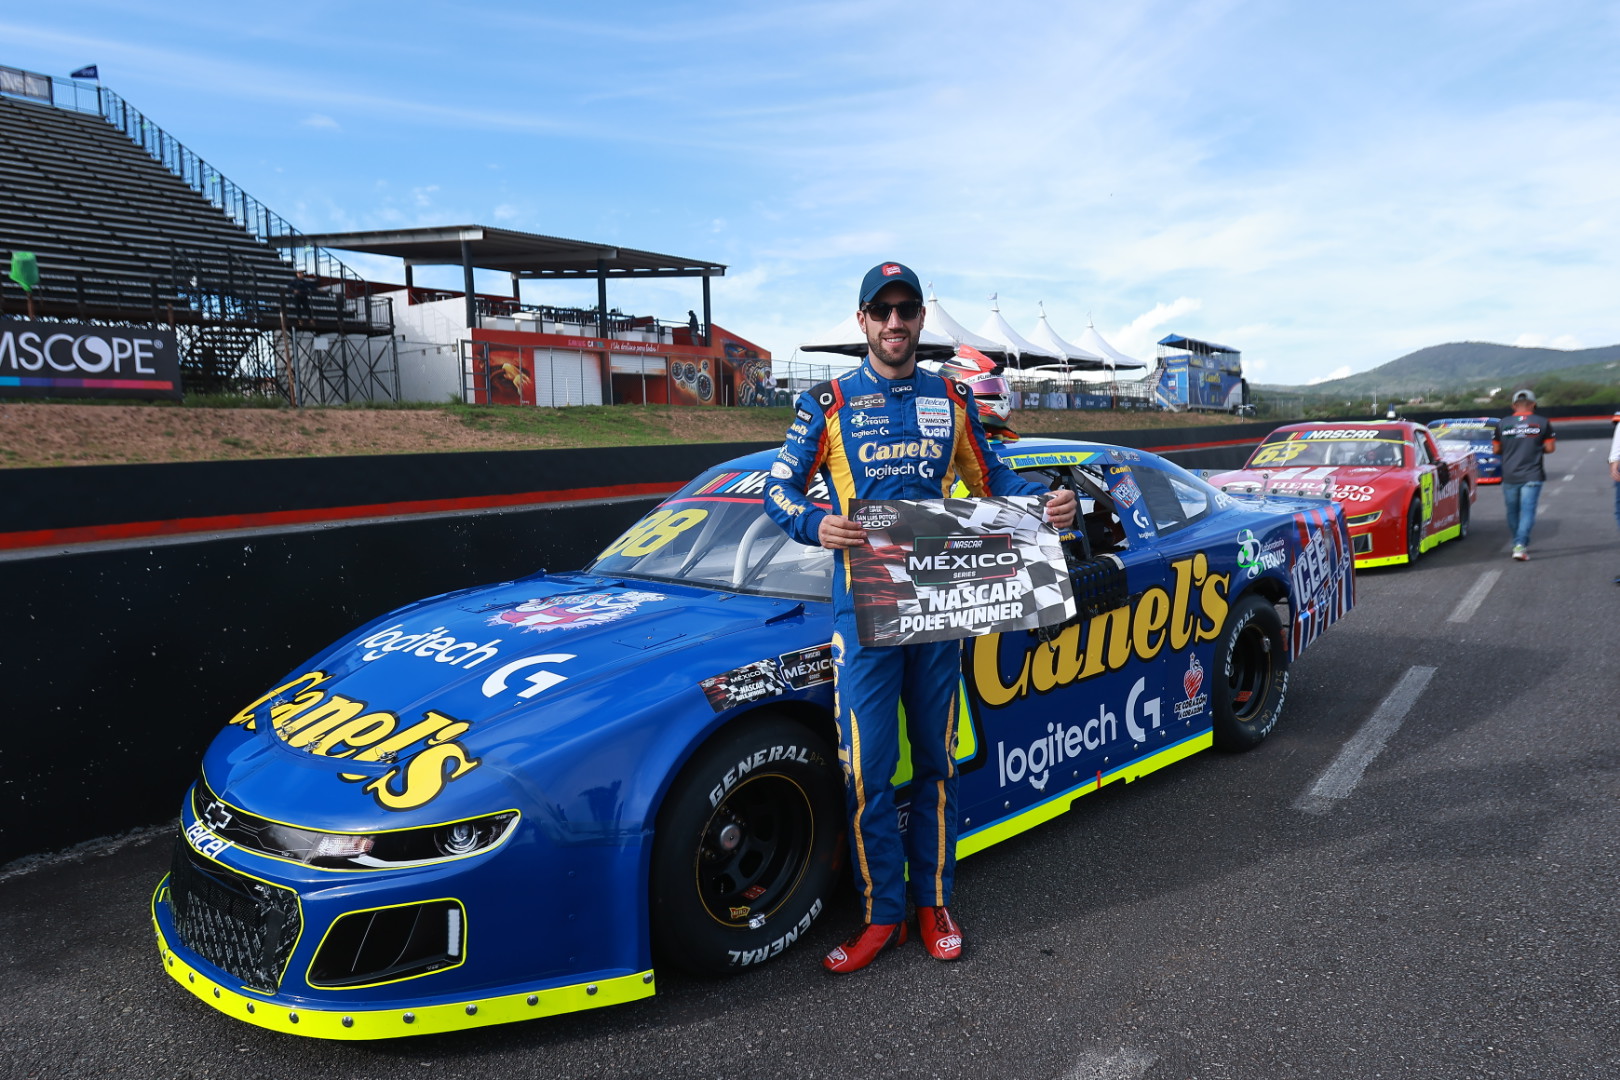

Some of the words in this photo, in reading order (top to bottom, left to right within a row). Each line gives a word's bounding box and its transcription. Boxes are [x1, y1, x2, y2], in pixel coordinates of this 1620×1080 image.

[851, 429, 878, 439] logitech
[1308, 429, 1379, 440] NASCAR
[858, 438, 943, 464] Canel's
[1251, 443, 1308, 465] 63
[865, 462, 915, 480] logitech
[1270, 481, 1375, 494] HERALDO
[597, 509, 709, 561] 88
[862, 520, 891, 528] 200
[953, 540, 983, 549] NASCAR
[909, 551, 1019, 571] MÉXICO
[1260, 548, 1286, 571] TEQUIS
[1291, 528, 1328, 614] ICEE
[953, 570, 977, 579] SERIES
[928, 580, 1022, 612] NASCAR
[899, 614, 945, 633] POLE
[949, 602, 1024, 628] WINNER
[974, 552, 1230, 706] Canel's
[356, 623, 502, 670] logitech
[1224, 609, 1256, 677] GENERAL
[784, 657, 834, 680] MÉXIC
[228, 670, 480, 810] Canel's
[997, 704, 1118, 790] logitech
[709, 745, 808, 808] GENERAL
[186, 819, 235, 858] telcel
[727, 898, 823, 967] GENERAL
